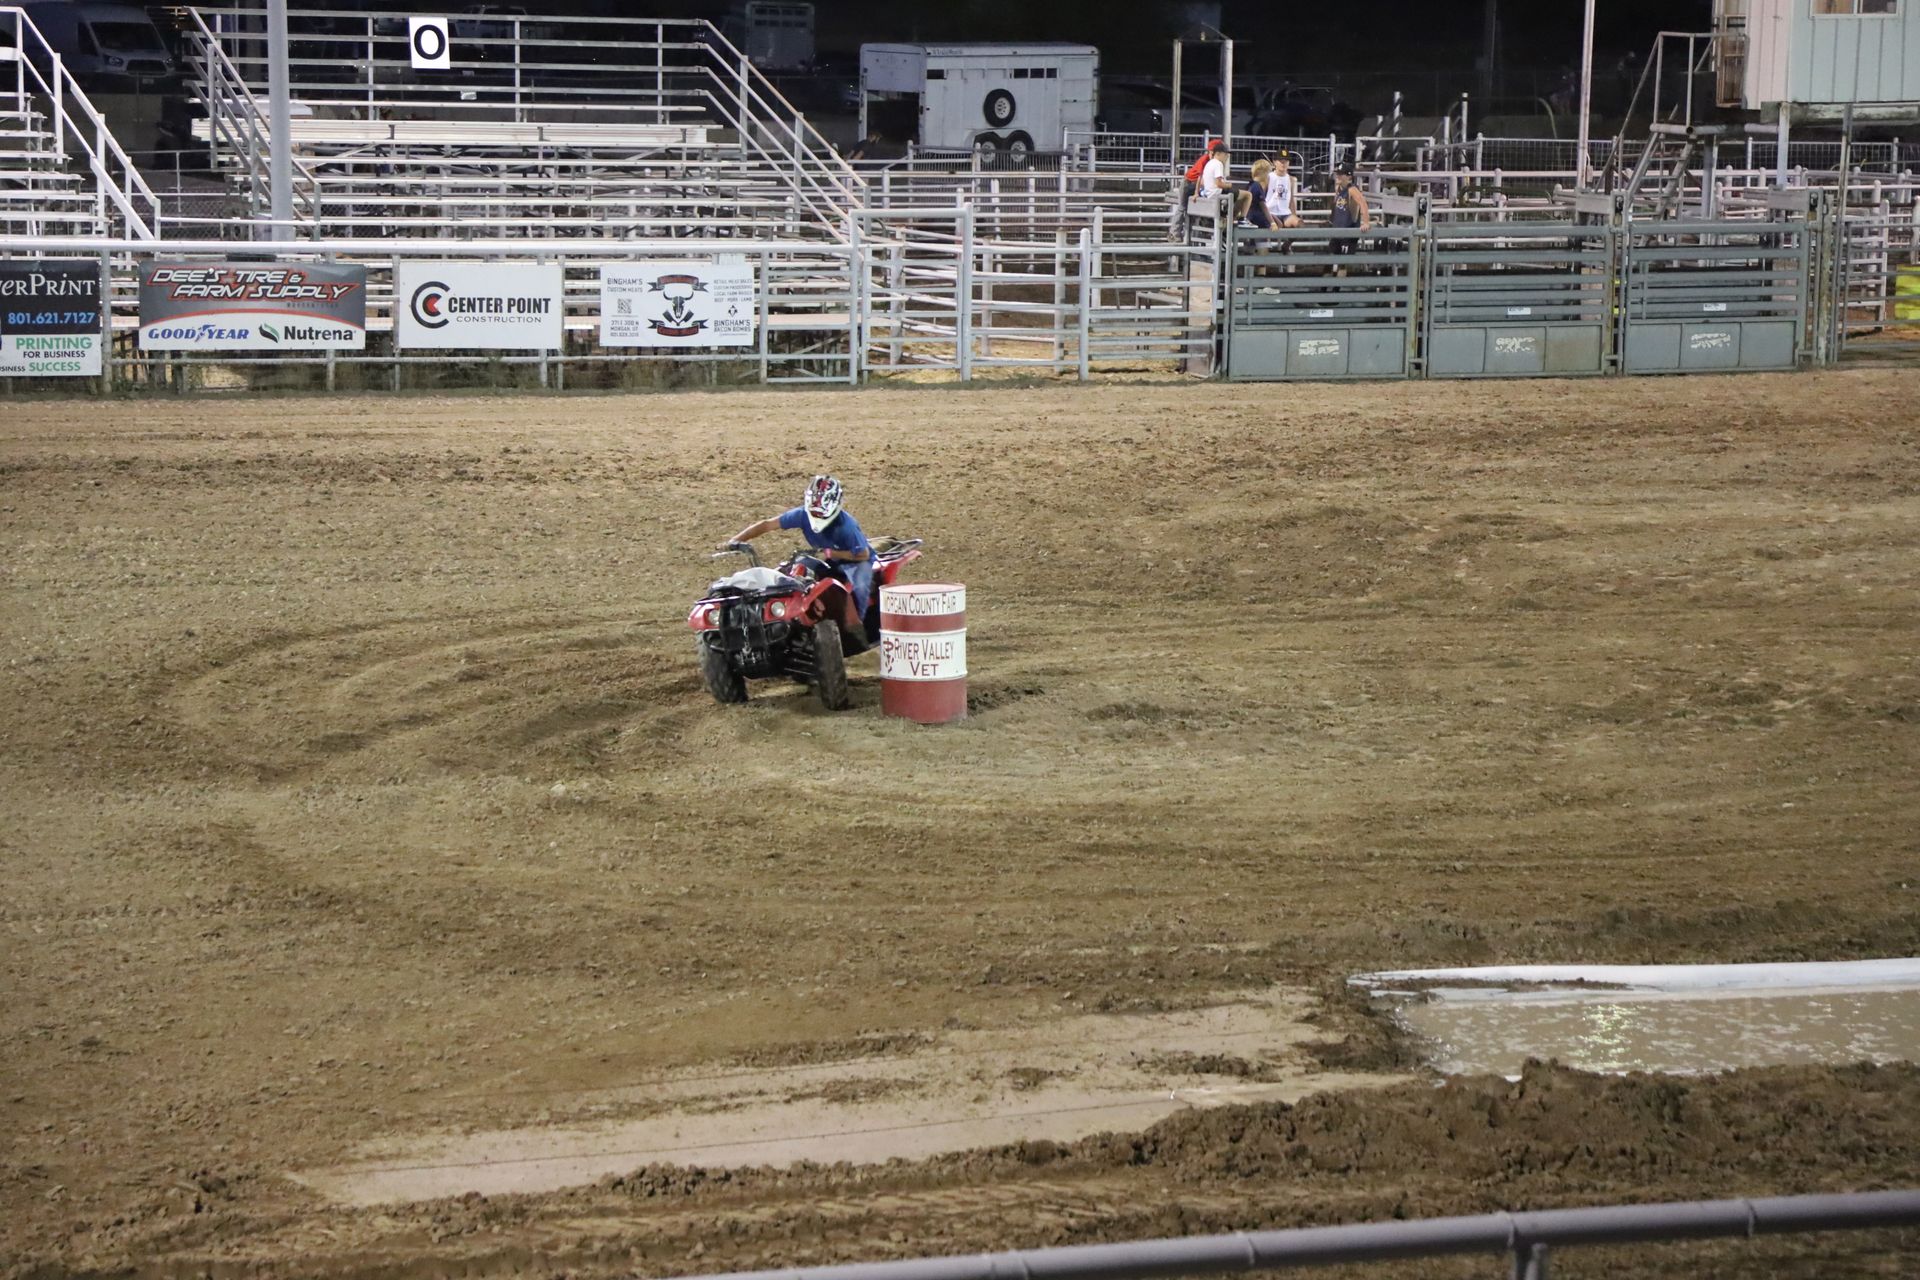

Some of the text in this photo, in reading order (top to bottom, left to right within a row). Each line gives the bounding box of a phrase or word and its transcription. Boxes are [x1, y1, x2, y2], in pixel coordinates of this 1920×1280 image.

[152, 268, 228, 283] DEE'S
[235, 270, 284, 283] TIRE
[173, 284, 351, 299] FARM SUPPLY
[448, 296, 552, 314] CENTER POINT
[8, 312, 96, 324] 801.621.7127
[456, 315, 542, 323] CONSTRUCTION
[284, 326, 354, 341] Nutrena
[16, 336, 92, 350] PRINTING
[23, 350, 86, 358] FOR BUSINESS
[28, 361, 81, 372] SUCCESS
[908, 594, 940, 614] COUNTY
[941, 593, 957, 612] FAIR
[922, 639, 955, 660] VALLEY
[910, 661, 940, 676] VET
